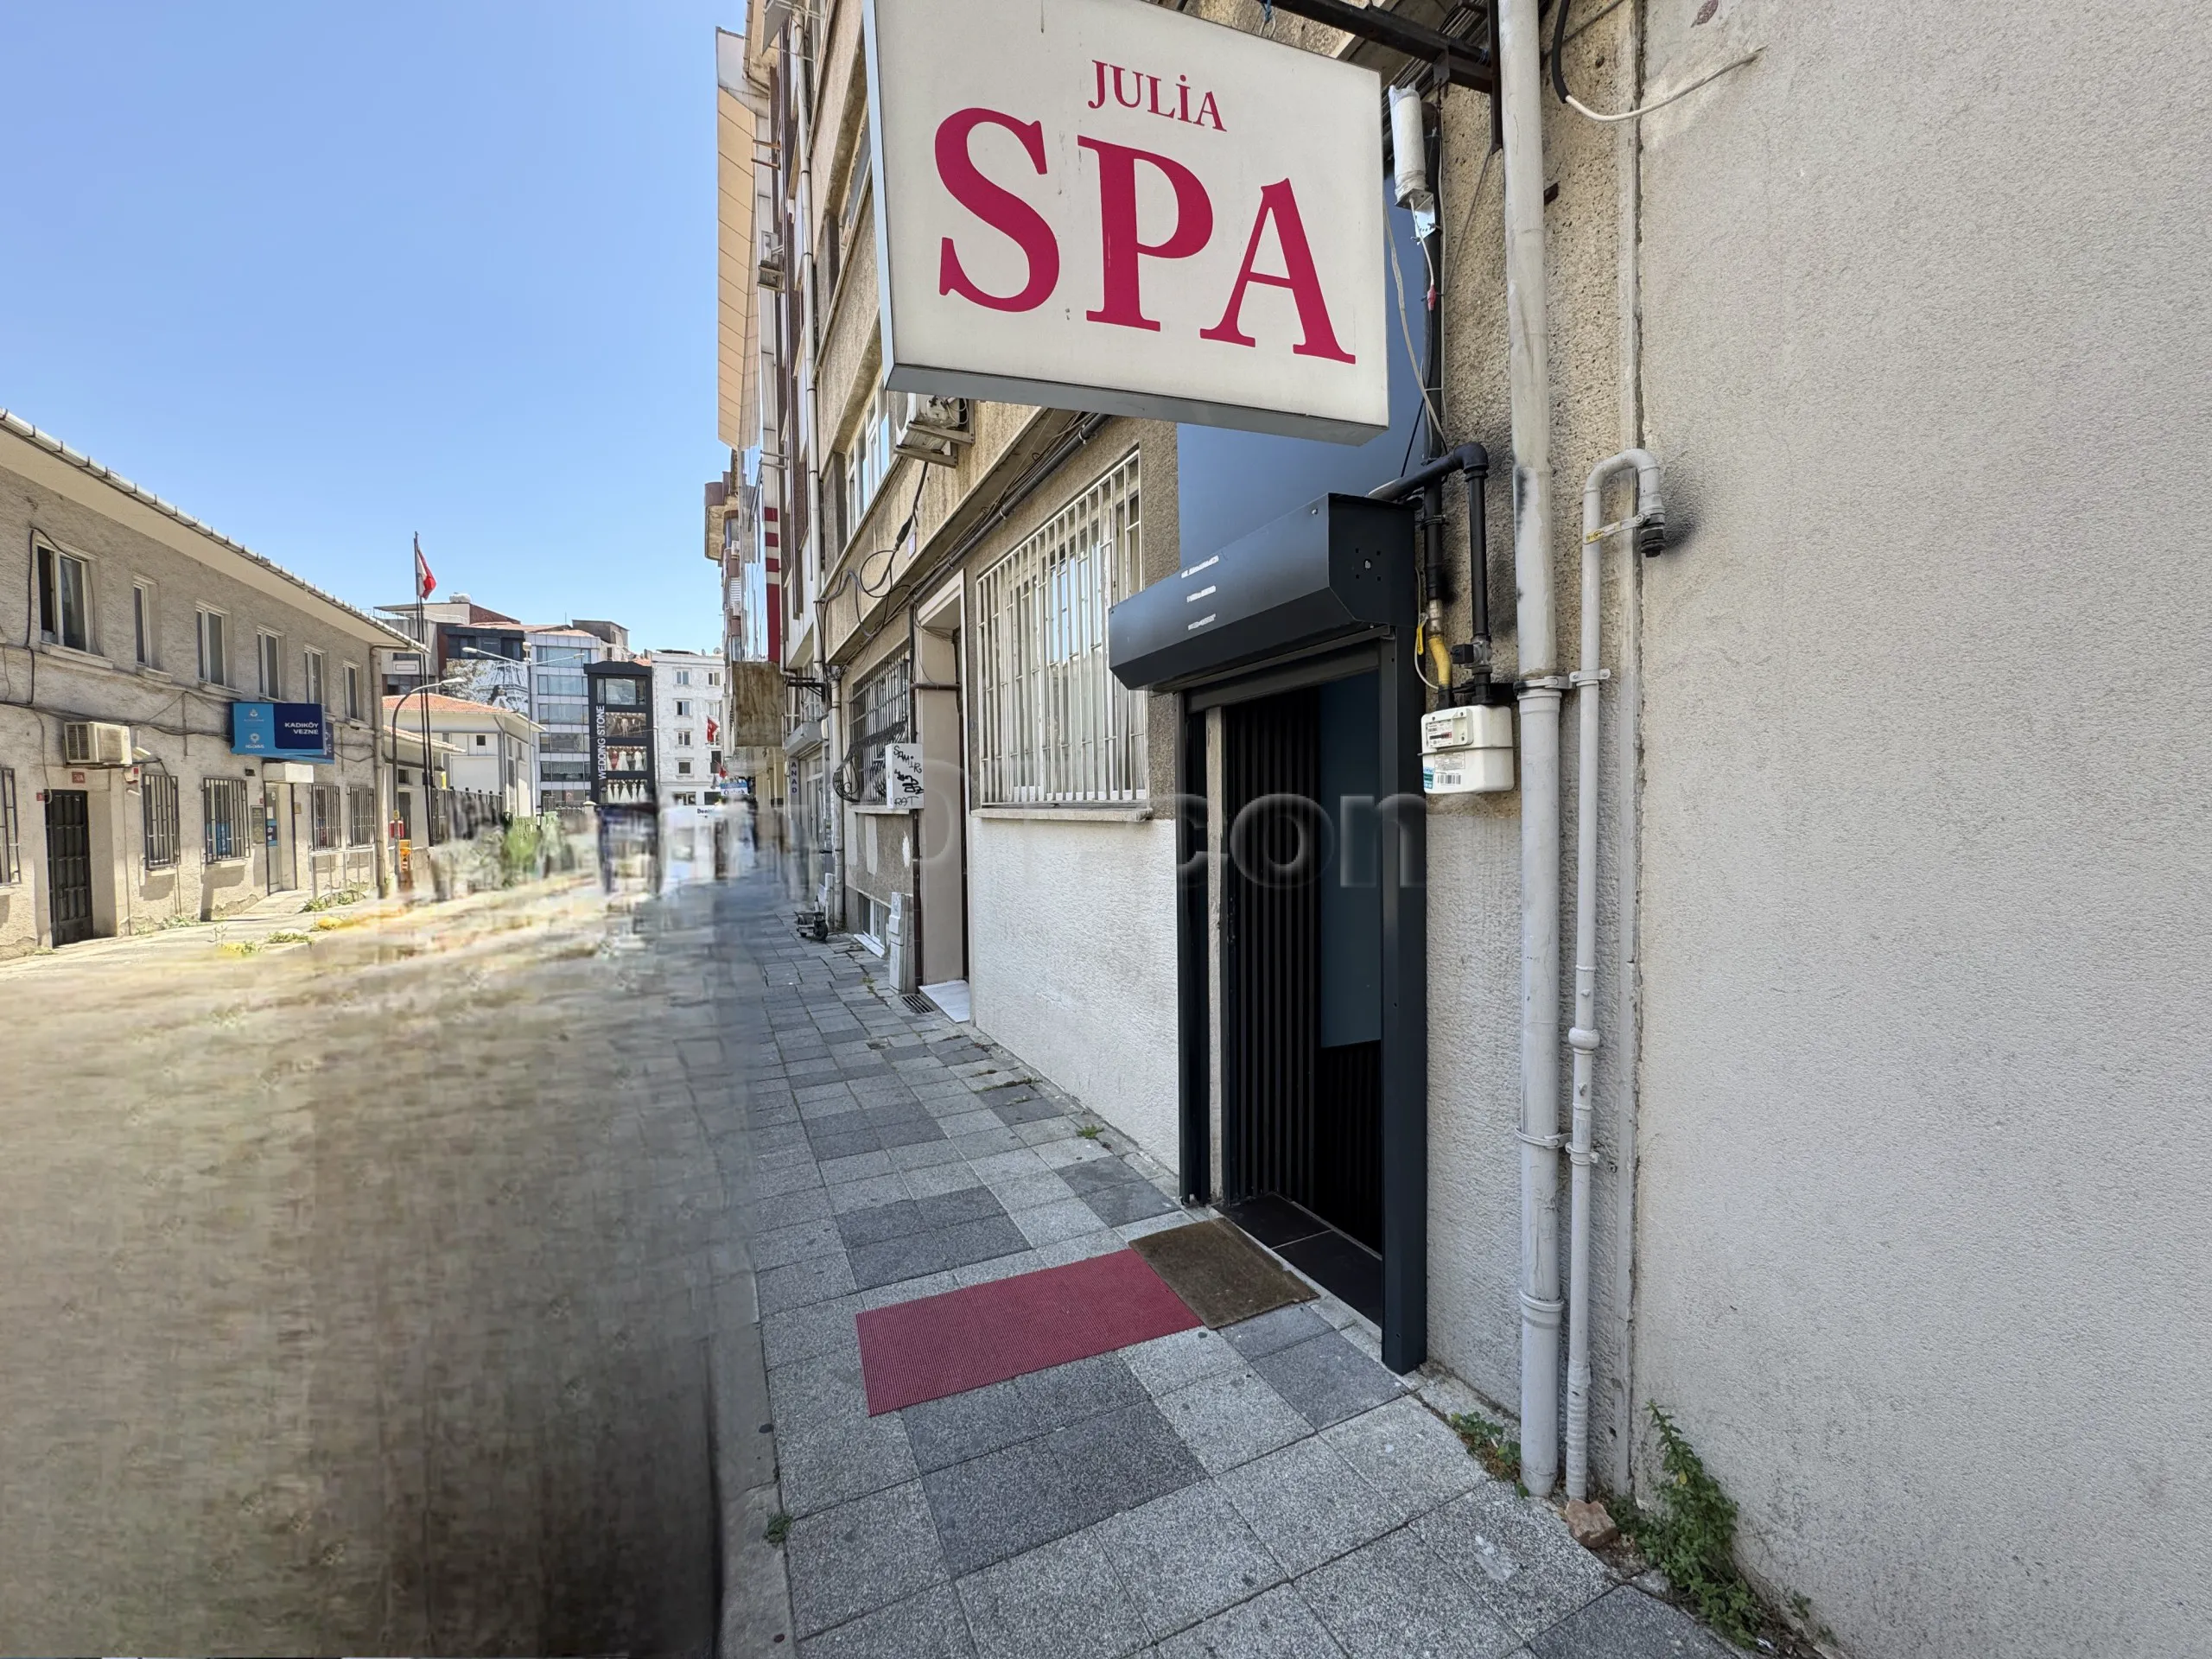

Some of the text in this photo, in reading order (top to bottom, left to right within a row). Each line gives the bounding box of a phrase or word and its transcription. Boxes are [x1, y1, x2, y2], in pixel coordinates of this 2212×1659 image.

[1088, 60, 1226, 132] JULİA
[934, 107, 1356, 365] SPA
[596, 705, 607, 780] WEDDING STONE
